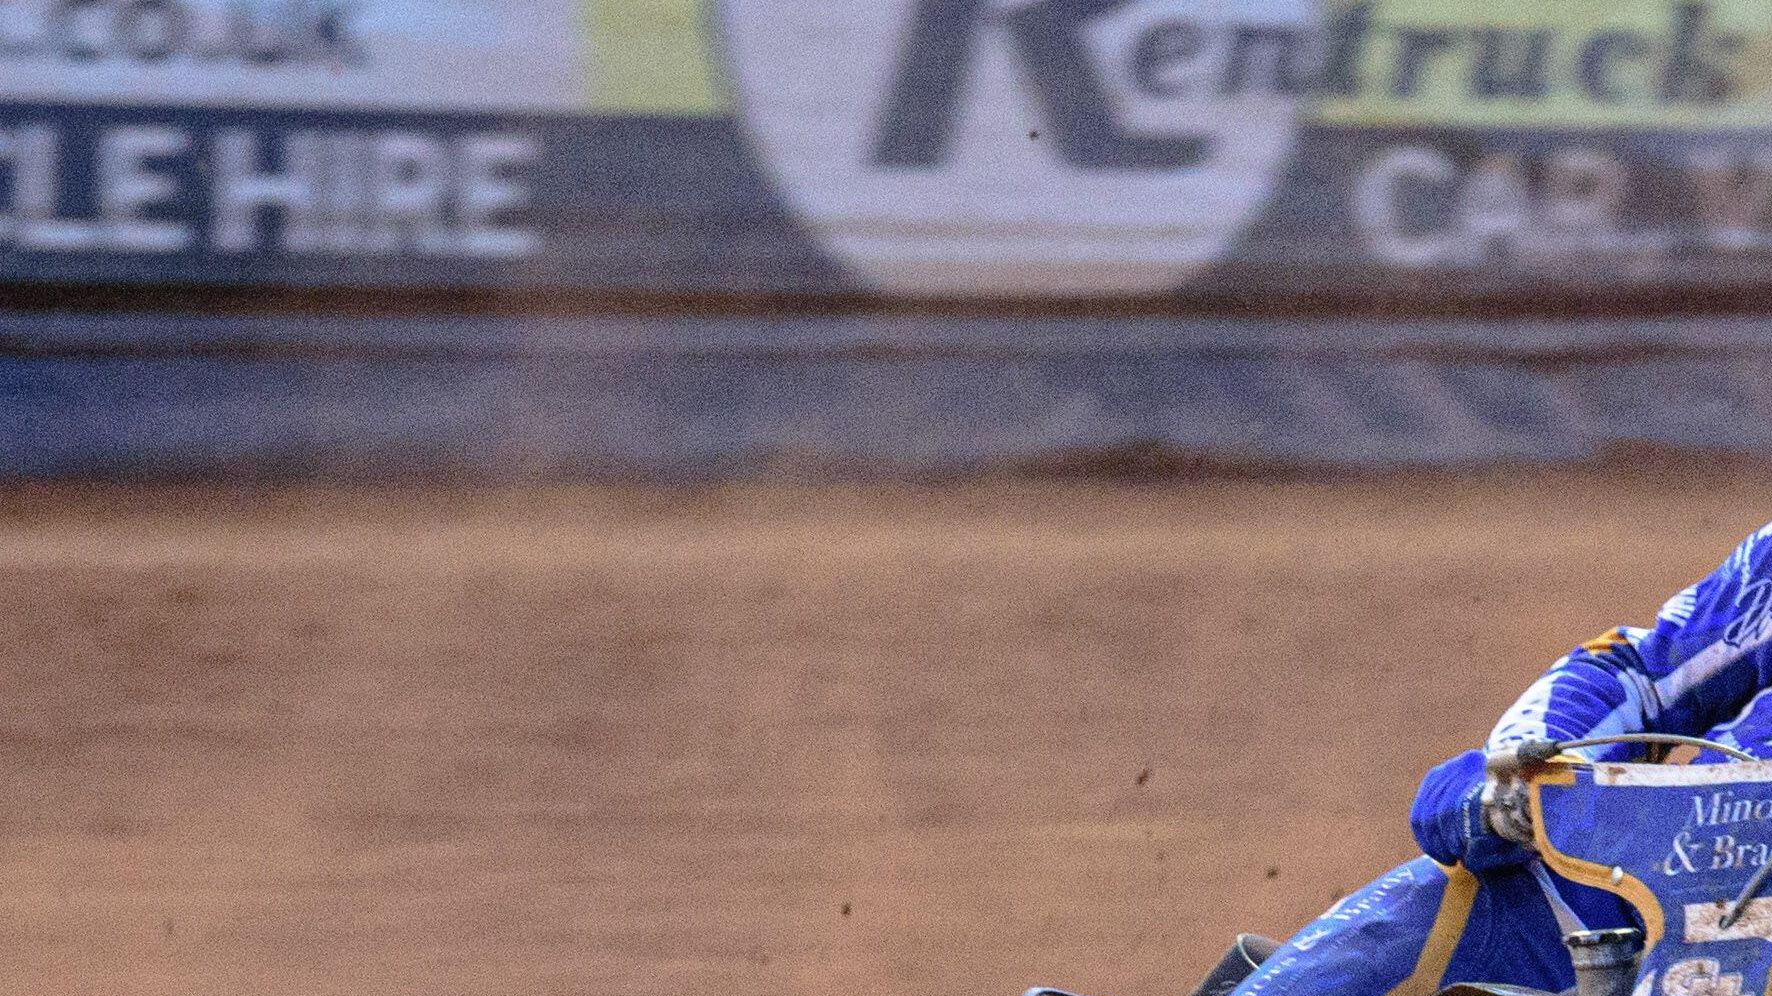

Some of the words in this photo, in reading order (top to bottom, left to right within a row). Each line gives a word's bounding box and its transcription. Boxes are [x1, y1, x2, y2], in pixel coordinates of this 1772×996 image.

[208, 126, 545, 258] HIRE
[1350, 145, 1634, 266] CAR
[1663, 831, 1703, 876] &
